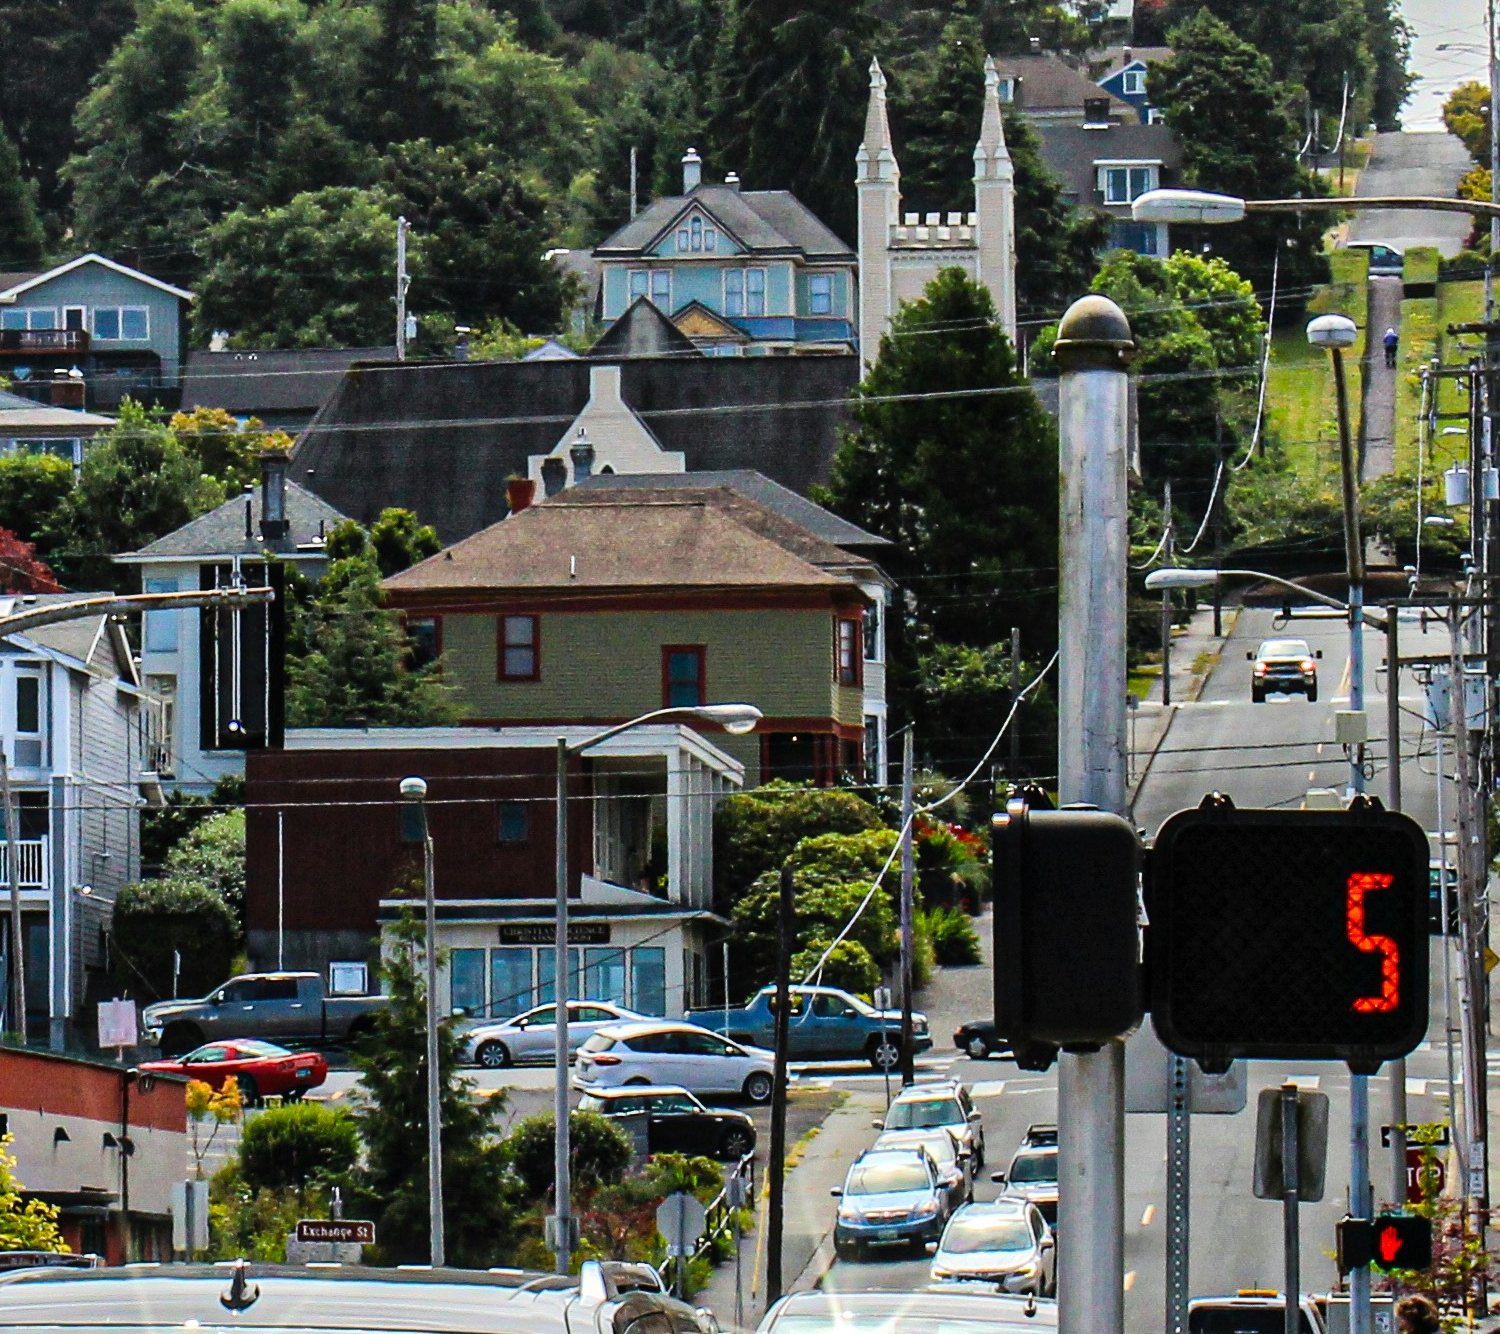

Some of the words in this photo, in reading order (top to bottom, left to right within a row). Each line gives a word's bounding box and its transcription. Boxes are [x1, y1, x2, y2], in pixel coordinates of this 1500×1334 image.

[1346, 872, 1401, 1013] 5
[303, 1225, 352, 1239] Exchange
[357, 1226, 368, 1238] St
